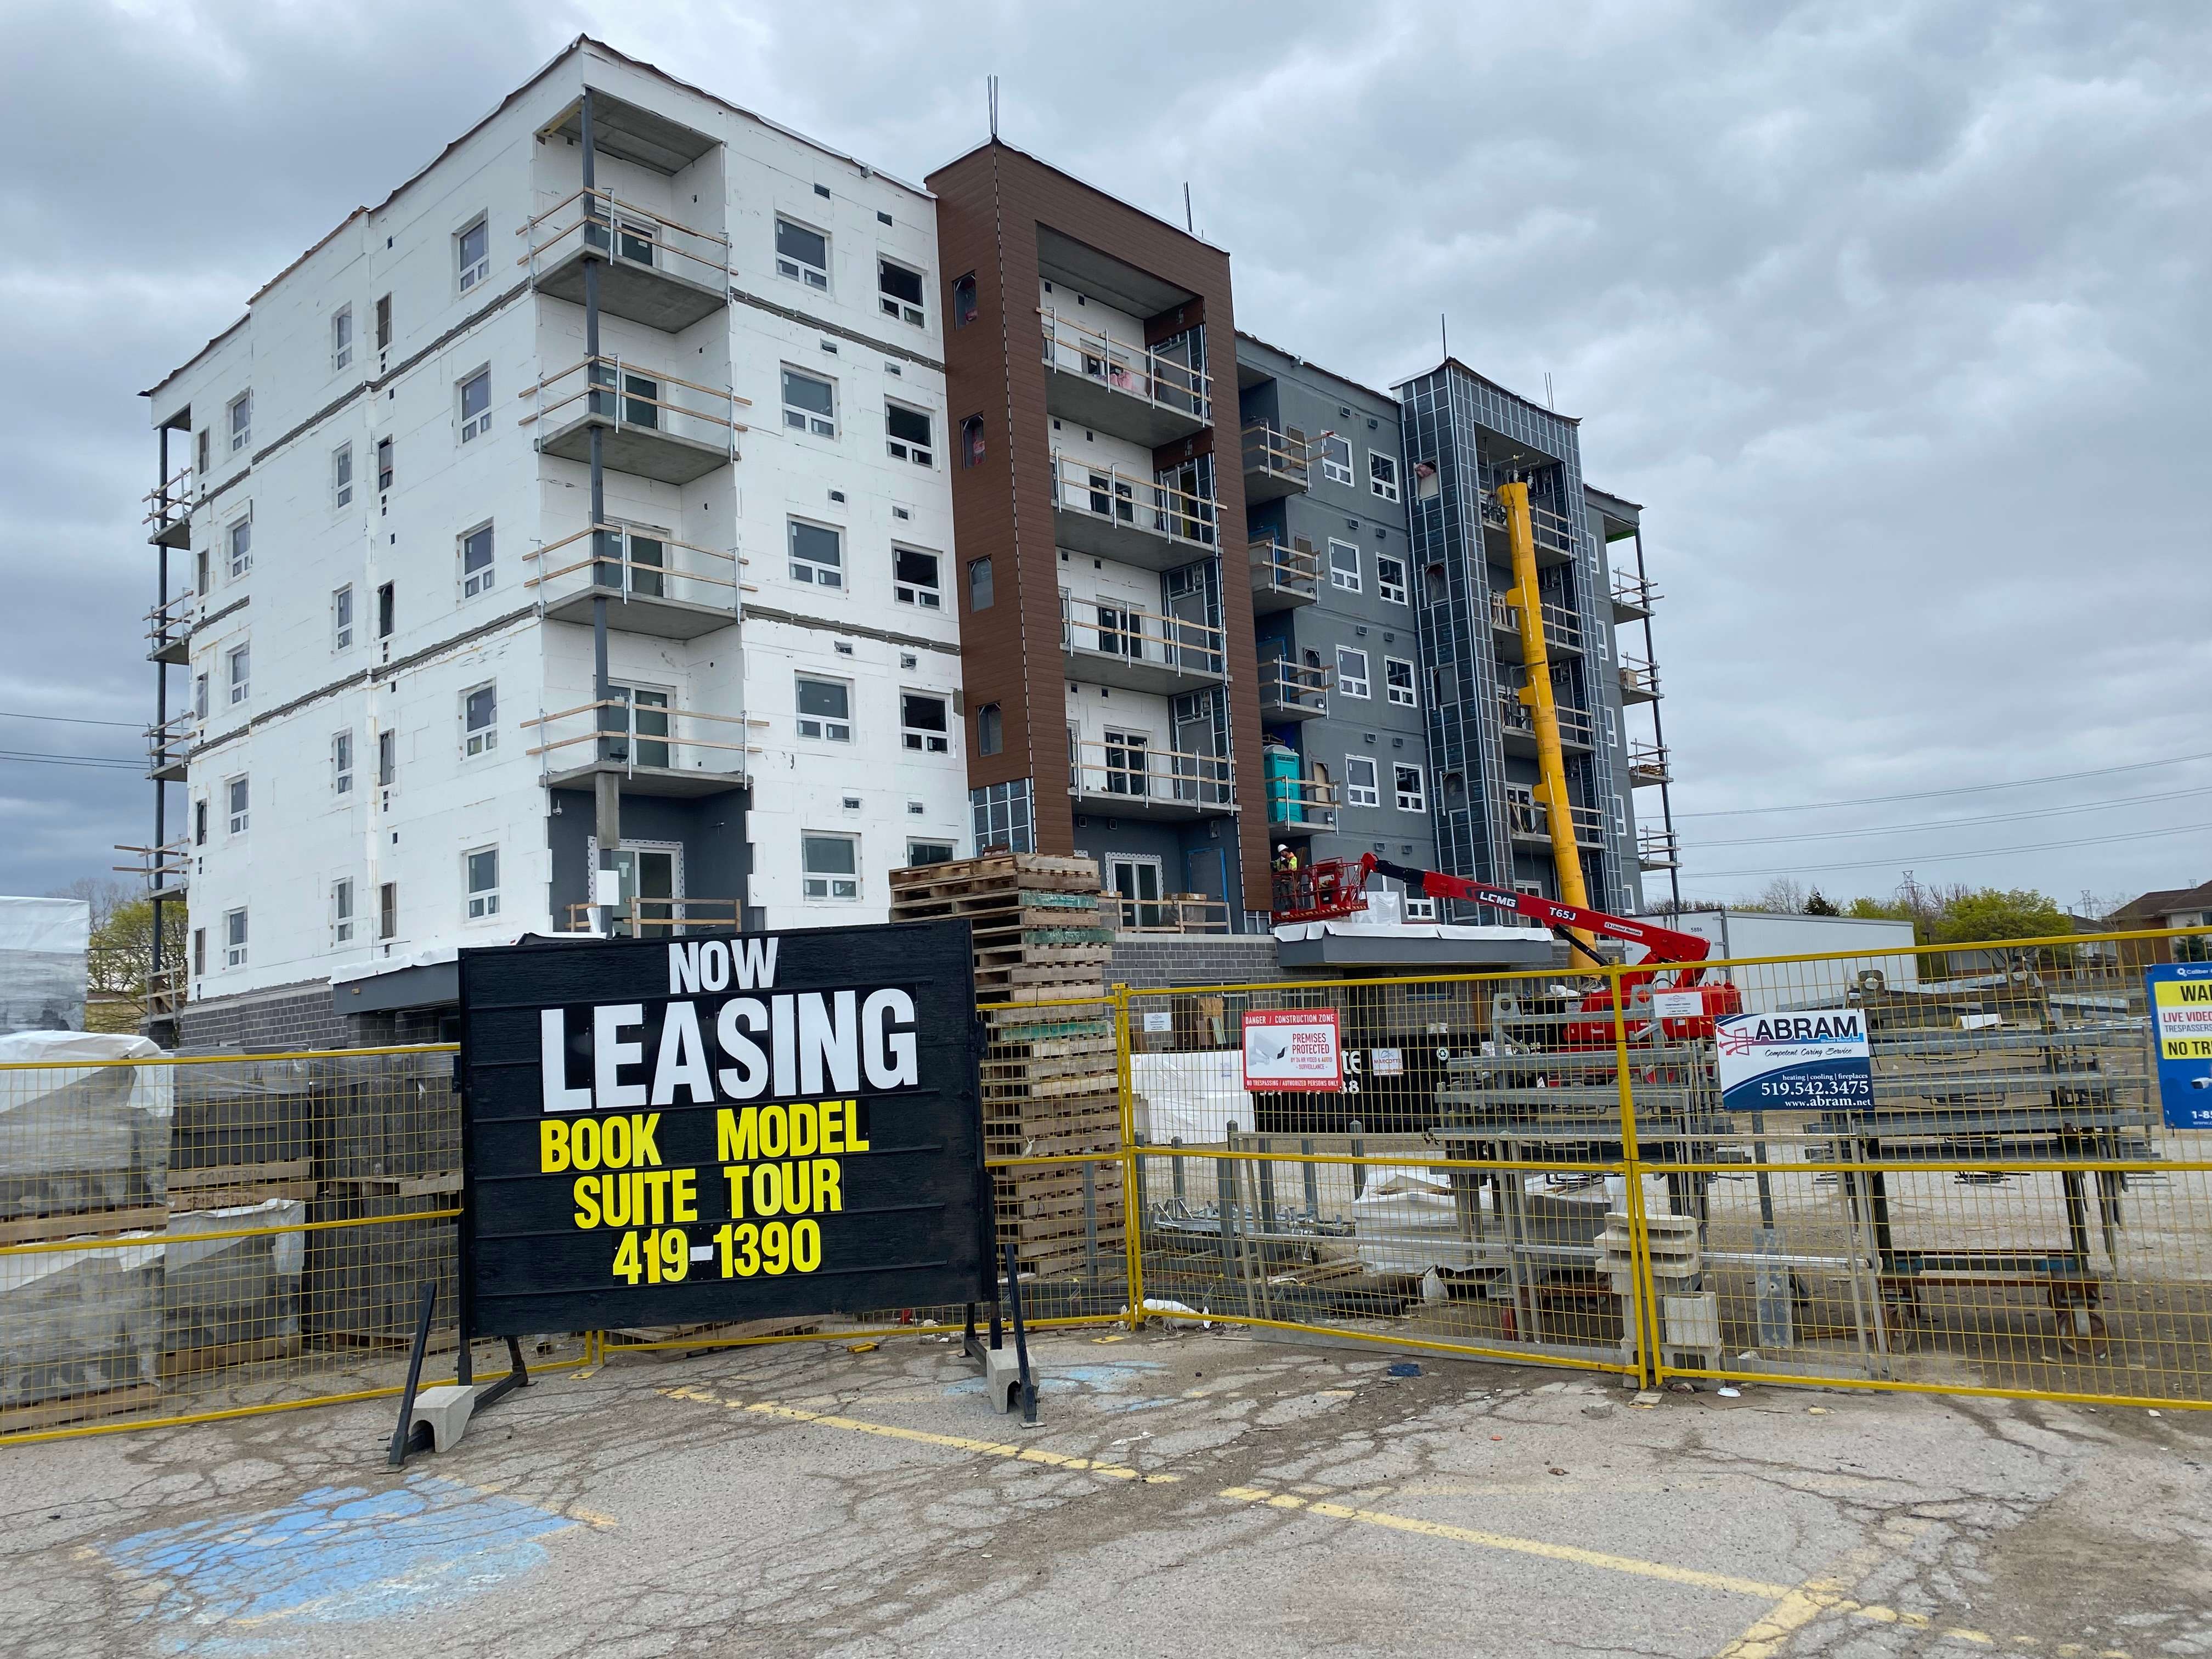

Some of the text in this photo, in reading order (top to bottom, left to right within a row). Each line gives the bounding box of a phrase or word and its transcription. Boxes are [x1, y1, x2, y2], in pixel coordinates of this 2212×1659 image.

[1480, 891, 1516, 907] LCMG
[1549, 907, 1576, 921] T65J
[668, 937, 779, 994] NOW
[1245, 1016, 1266, 1024] DANGER
[1275, 1014, 1317, 1023] CONSTRUCTION
[1319, 1014, 1334, 1022] ZONE
[2163, 1012, 2183, 1023] LIVE
[1755, 1016, 1858, 1040] ABRAM
[1293, 1033, 1326, 1043] PREMISES
[541, 988, 918, 1112] LEASING
[1292, 1044, 1329, 1054] PROTECTED
[1765, 1047, 1852, 1058] Competent Caring Service
[2168, 1041, 2212, 1055] NO TR
[1762, 1081, 1869, 1096] 519.542.3475
[1785, 1096, 1871, 1107] www.abram.net
[540, 1100, 869, 1172] BOOK MODEL
[574, 1159, 842, 1229] SUITE TOUR
[613, 1220, 821, 1285] 419-1390
